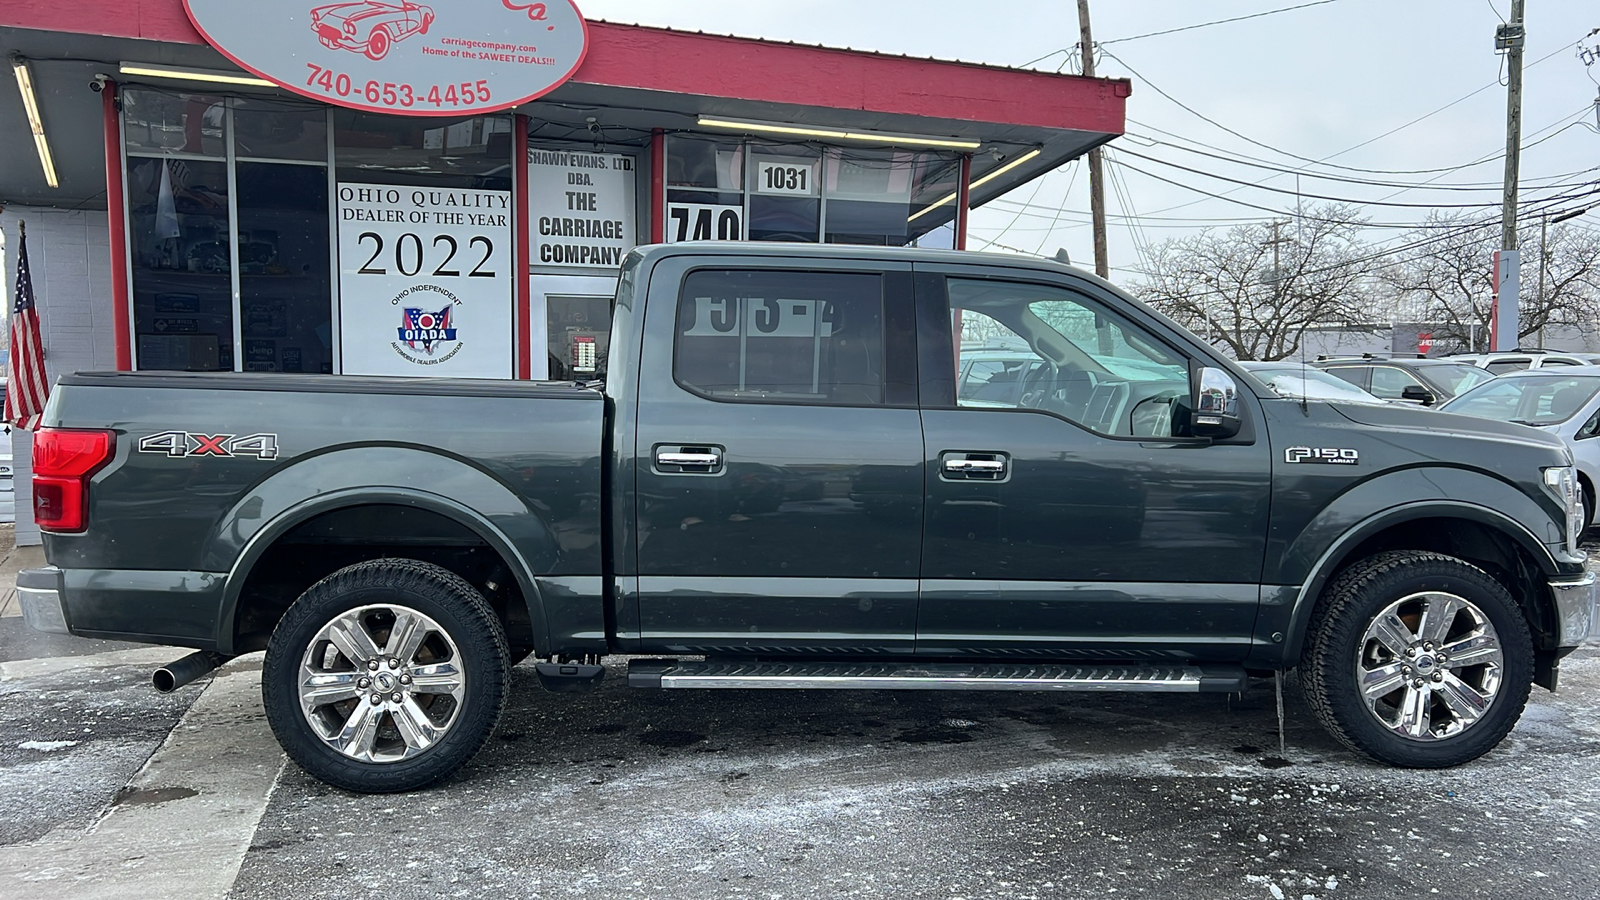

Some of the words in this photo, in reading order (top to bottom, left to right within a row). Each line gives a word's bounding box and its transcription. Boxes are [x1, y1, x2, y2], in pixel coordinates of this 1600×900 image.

[422, 46, 449, 57] Home
[451, 49, 460, 58] of
[462, 51, 476, 59] the
[478, 52, 516, 63] SAWEET
[518, 55, 556, 66] DEALS!!!
[441, 37, 537, 53] carriagecompany.com
[306, 62, 491, 107] 740-653-4455
[528, 151, 567, 167] SHAWN
[570, 154, 608, 170] EVANS.
[613, 157, 634, 171] LTD.
[567, 172, 594, 186] DBA.
[764, 166, 807, 190] 1031
[339, 187, 400, 204] OHIO
[411, 190, 509, 209] QUALITY
[565, 191, 597, 211] THE
[343, 208, 405, 223] DEALER
[409, 211, 430, 224] OF
[433, 212, 464, 225] THE
[468, 213, 507, 227] YEAR
[539, 216, 623, 239] CARRIAGE
[357, 231, 496, 278] 2022
[540, 243, 622, 266] COMPANY
[391, 289, 410, 306] OHIO
[410, 284, 463, 306] INDEPENDENT
[405, 330, 447, 340] OIADA
[391, 341, 416, 364] AUTOMOBILE
[439, 341, 464, 364] ASSOCIATION
